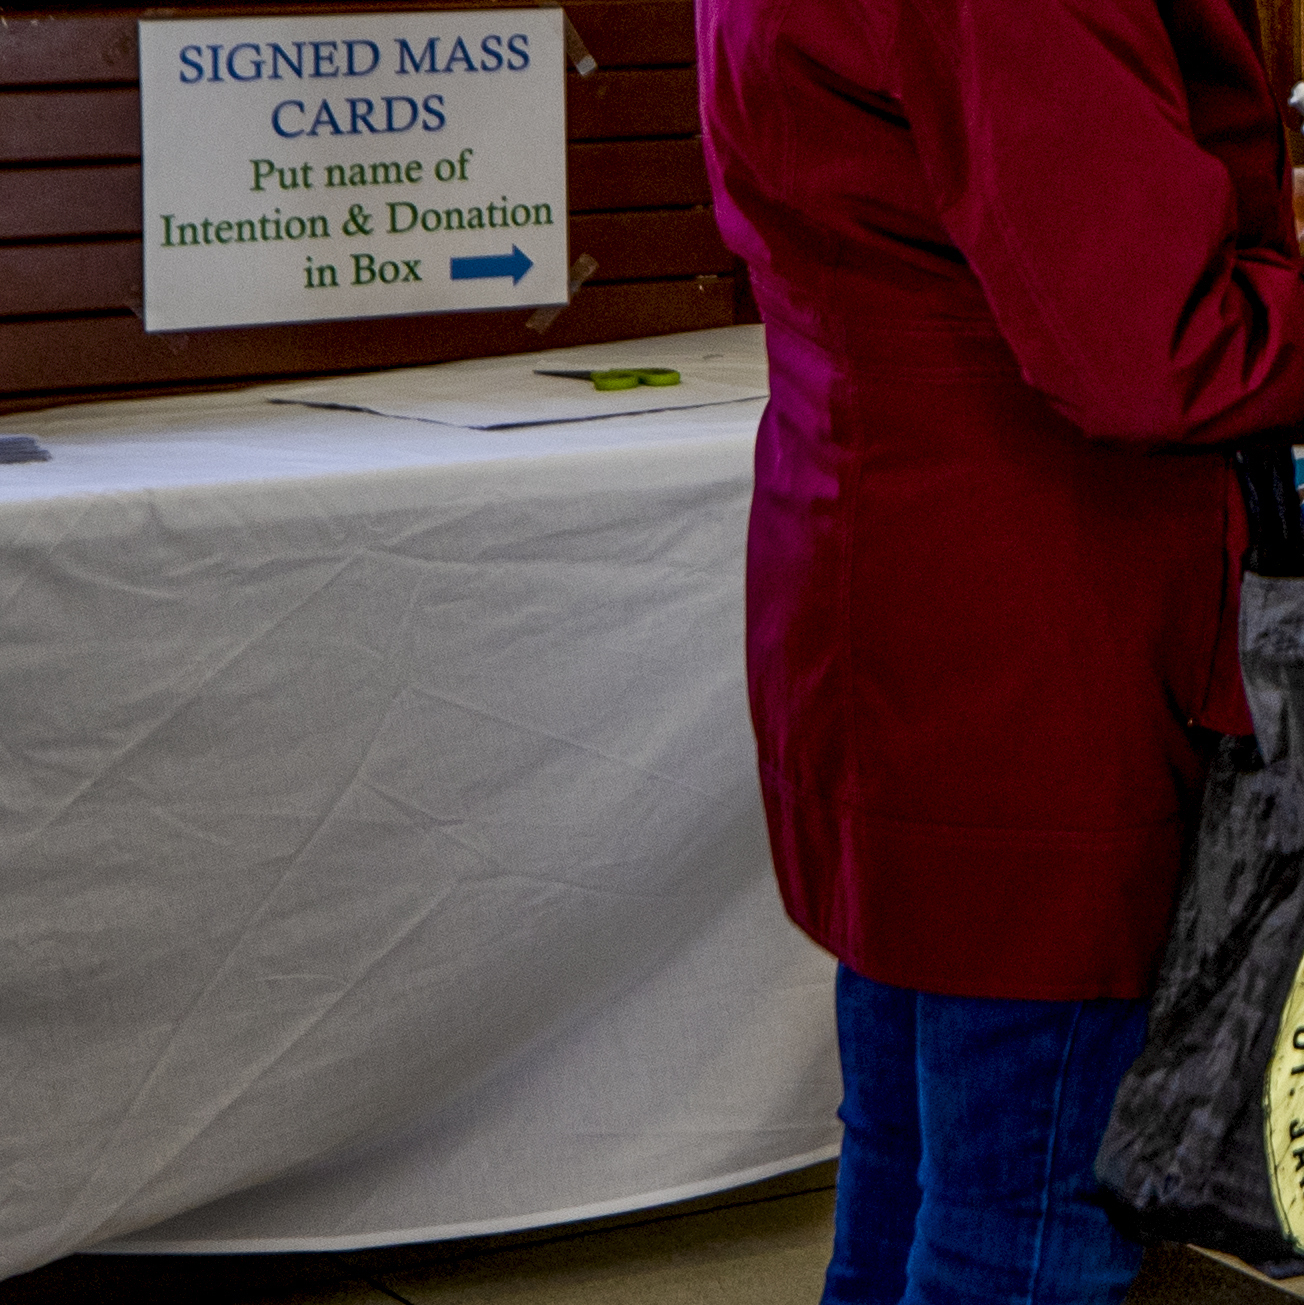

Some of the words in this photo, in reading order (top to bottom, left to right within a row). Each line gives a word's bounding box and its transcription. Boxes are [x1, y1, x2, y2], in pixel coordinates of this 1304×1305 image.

[180, 40, 381, 84] SIGNED
[394, 34, 530, 75] MASS
[271, 94, 446, 139] CARDS
[250, 159, 313, 191] Put
[325, 160, 423, 188] name
[434, 148, 473, 182] of
[161, 208, 331, 247] Intention
[342, 204, 373, 237] &
[386, 196, 553, 234] Donation
[305, 256, 339, 289] in
[351, 253, 422, 286] Box
